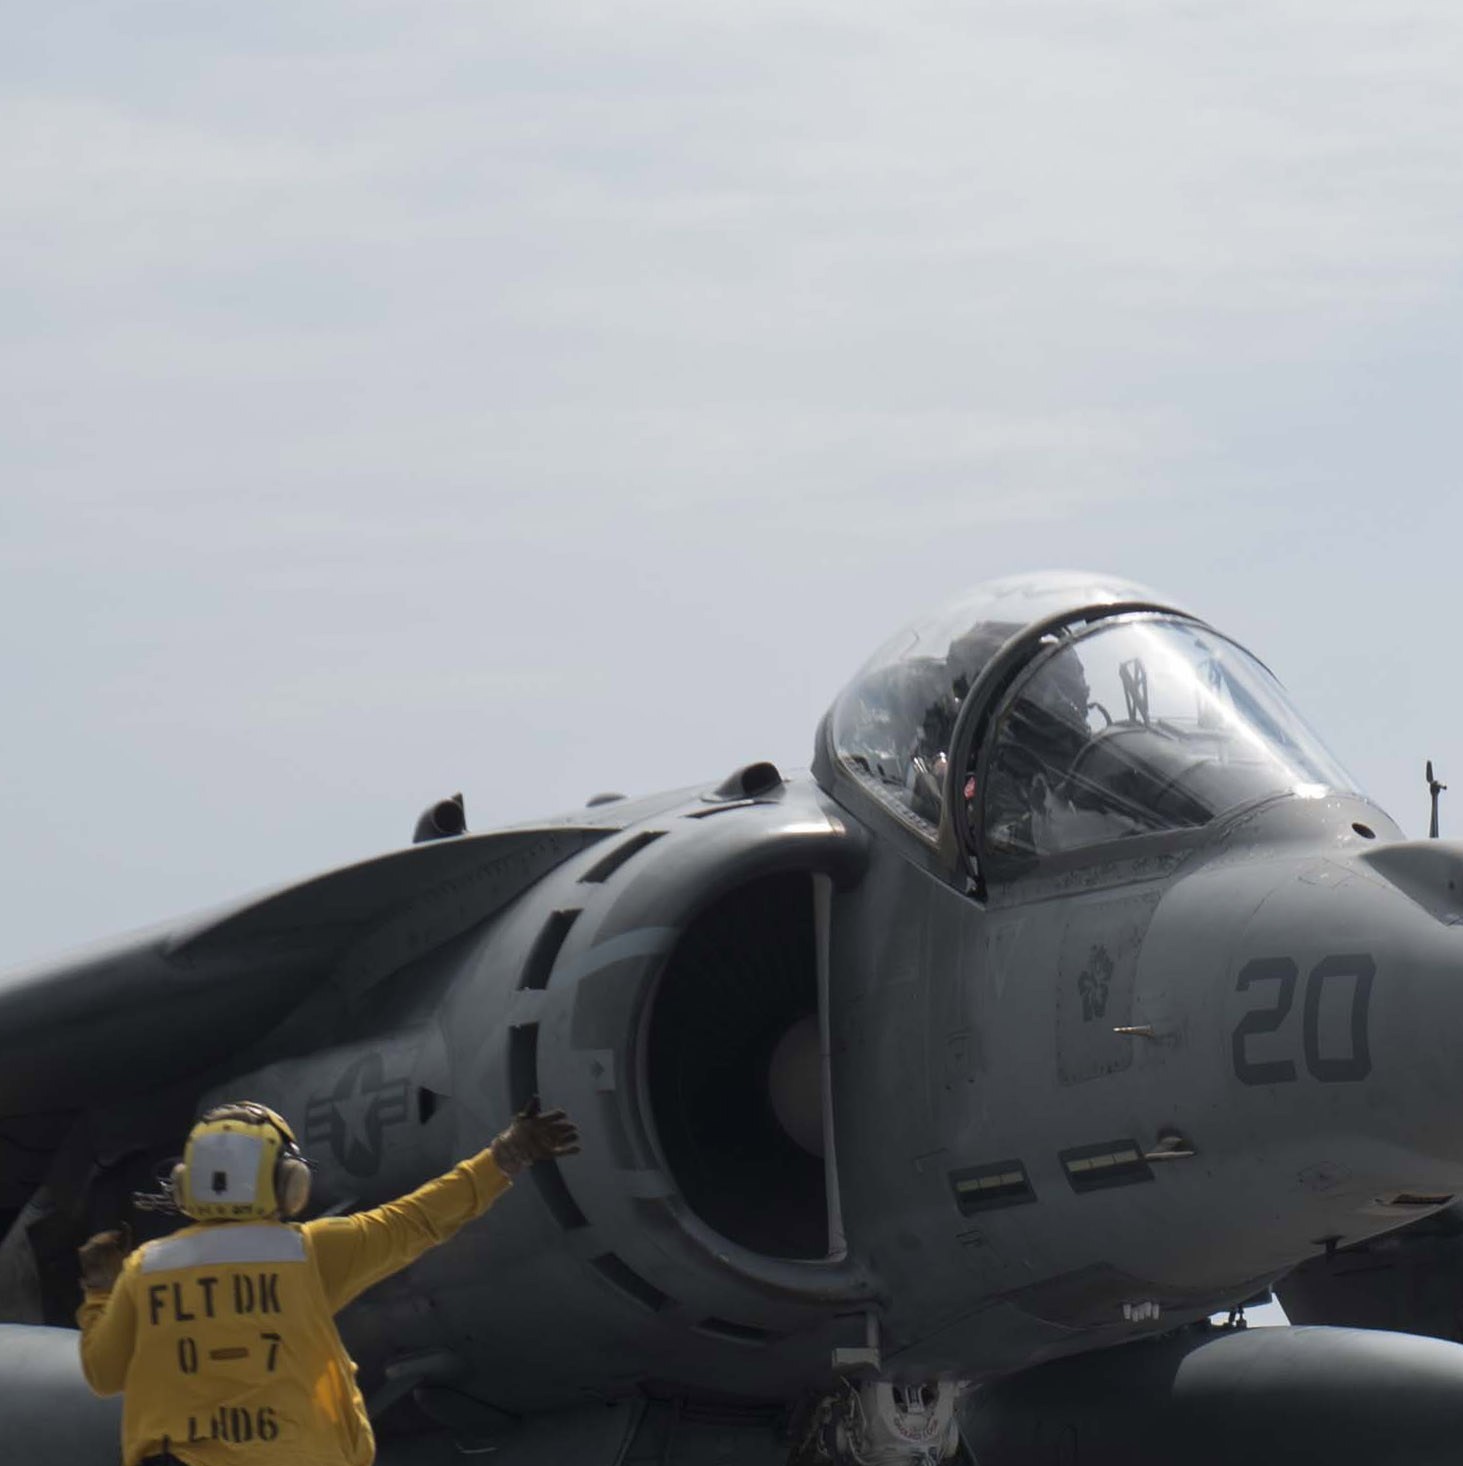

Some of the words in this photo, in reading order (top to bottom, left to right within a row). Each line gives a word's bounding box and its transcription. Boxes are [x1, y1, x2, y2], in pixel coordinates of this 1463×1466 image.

[1232, 954, 1377, 1086] 20
[149, 1278, 218, 1325] FLT
[233, 1273, 281, 1314] DK
